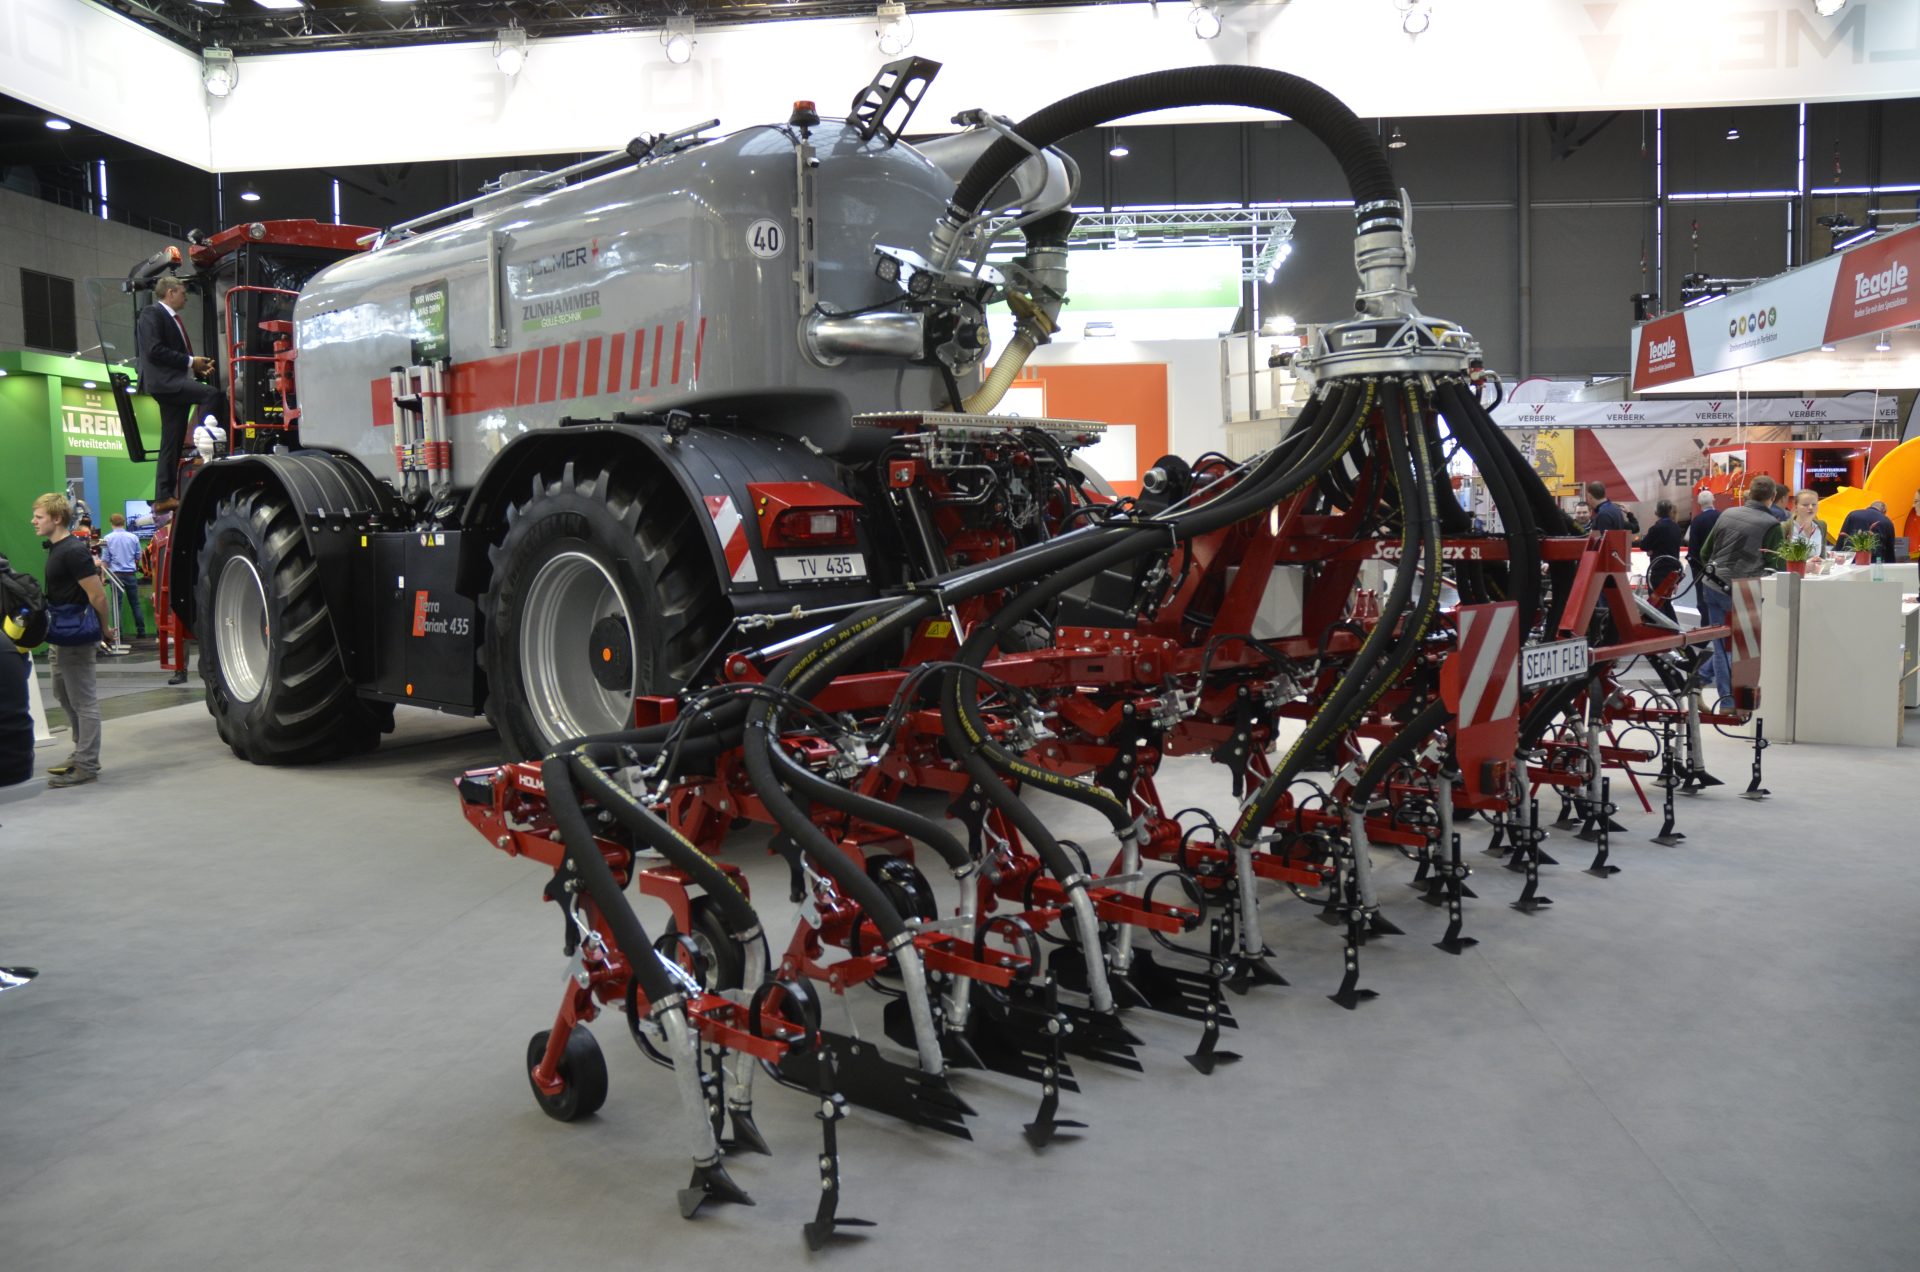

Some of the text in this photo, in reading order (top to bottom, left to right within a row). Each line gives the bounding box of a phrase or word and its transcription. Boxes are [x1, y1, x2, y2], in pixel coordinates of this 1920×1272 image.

[754, 226, 778, 251] 40
[527, 247, 587, 277] OLMER
[1855, 260, 1908, 299] Teagle
[522, 290, 600, 322] ZUNHAMMER
[1649, 335, 1676, 360] Teagle
[1695, 412, 1734, 420] VERBERK
[1789, 410, 1827, 418] VERBERK
[1880, 408, 1897, 416] VER
[63, 412, 124, 437] LREN
[68, 436, 123, 450] Verteiltechnik
[1658, 469, 1711, 486] VER
[1470, 547, 1482, 560] SL
[798, 556, 853, 577] TV 435
[419, 595, 440, 613] Terra
[417, 615, 469, 635] Variant 435
[1527, 644, 1587, 680] SECAT FLEX
[519, 774, 545, 791] HOLM
[1030, 769, 1043, 780] 10
[1044, 773, 1060, 785] PN
